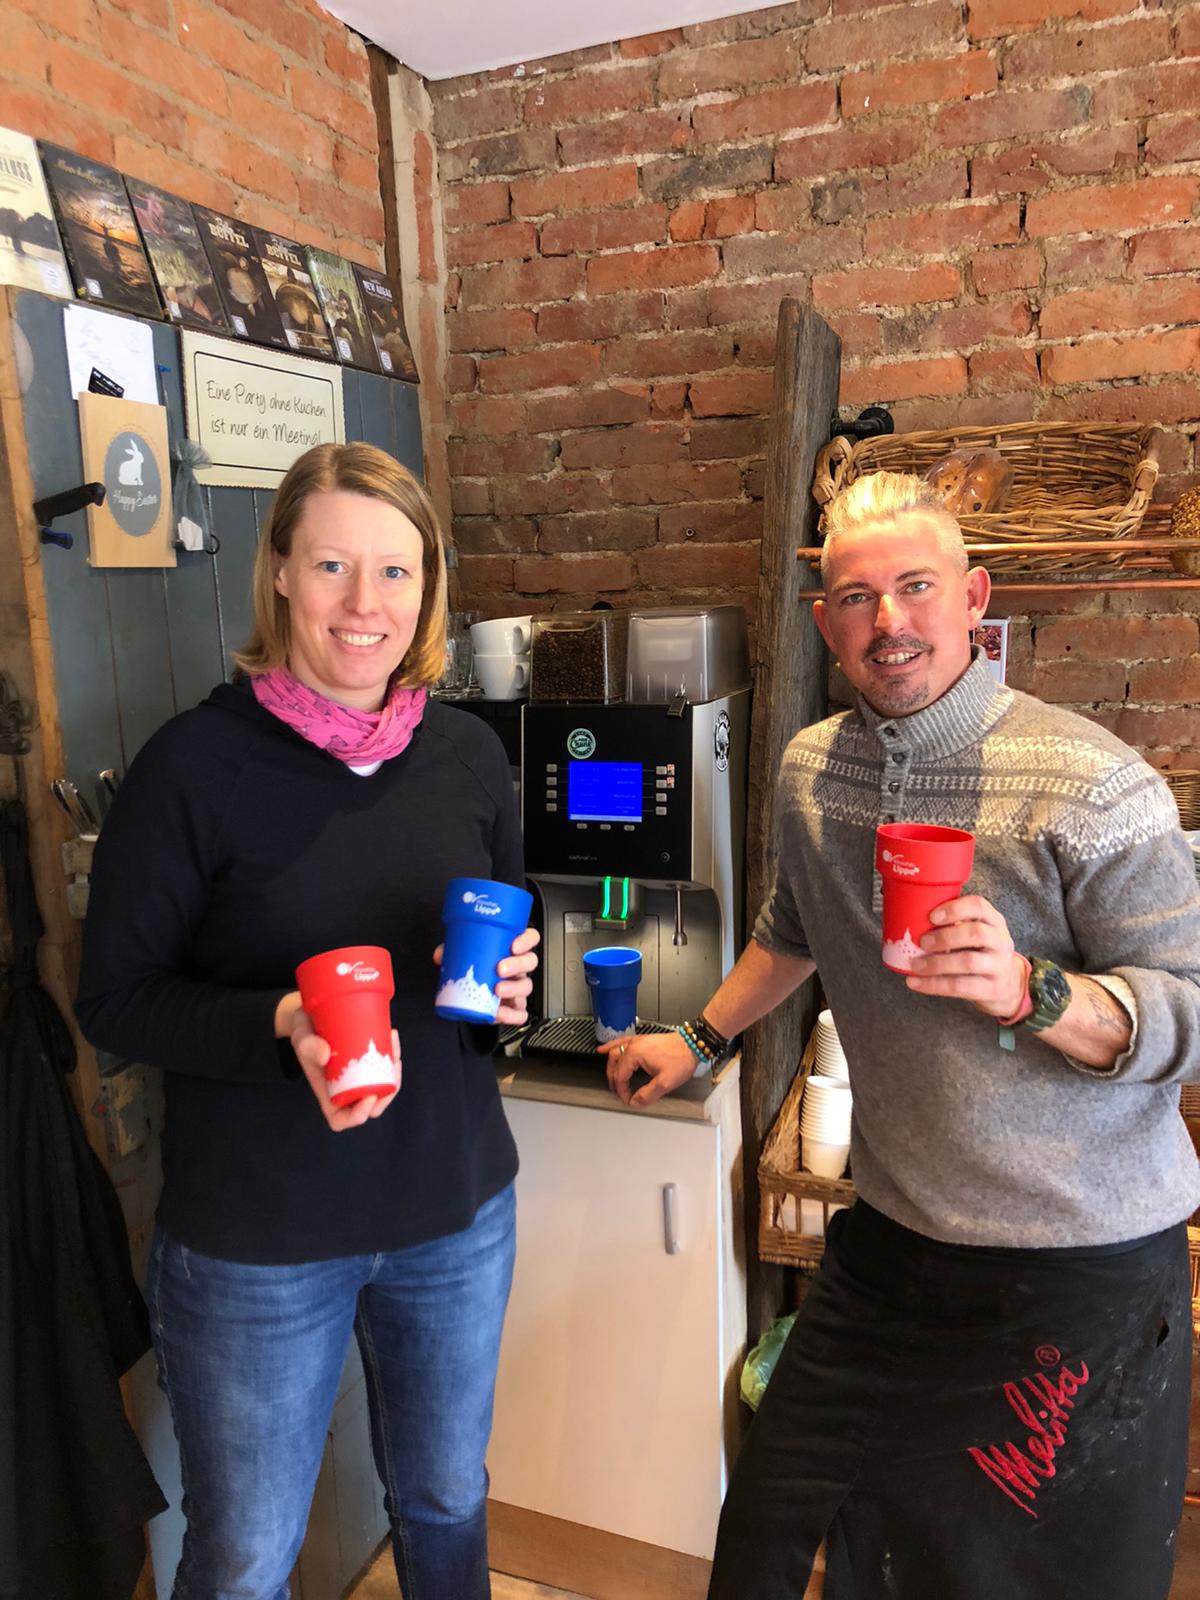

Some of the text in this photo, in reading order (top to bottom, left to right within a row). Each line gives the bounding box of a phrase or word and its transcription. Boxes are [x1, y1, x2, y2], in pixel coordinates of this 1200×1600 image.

[206, 380, 326, 417] Eine Party ohne Kuchen
[211, 414, 226, 435] ist
[230, 422, 249, 437] nur
[253, 421, 270, 441] ein
[966, 1360, 1090, 1519] Melitta
